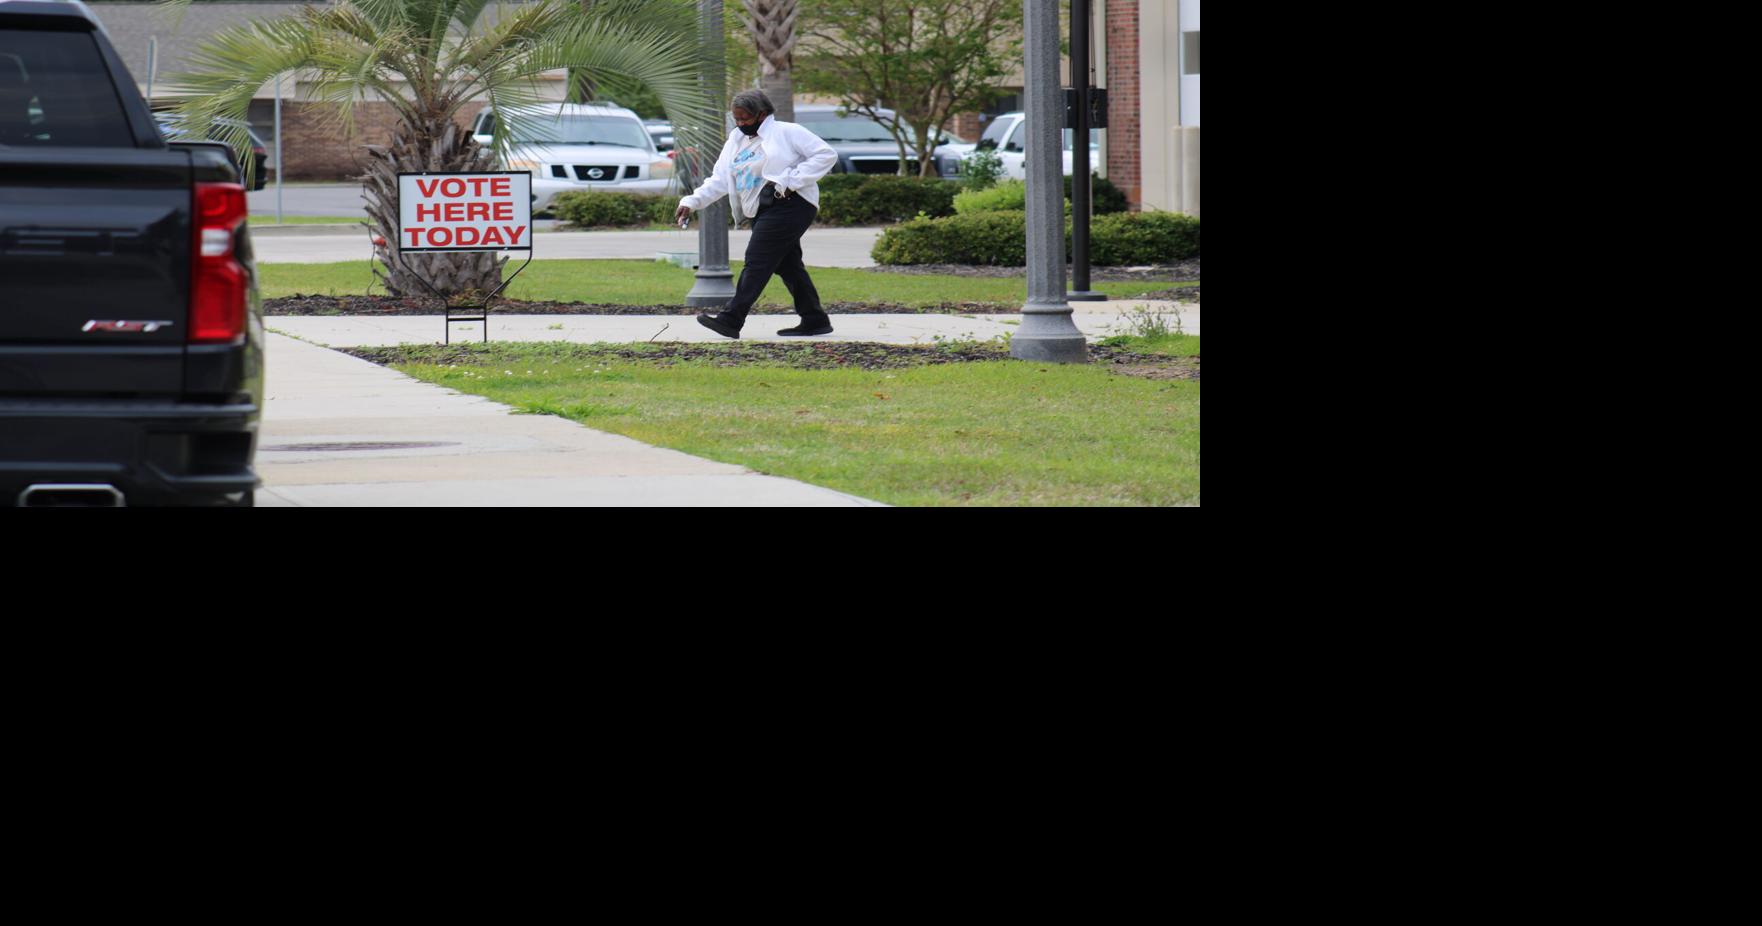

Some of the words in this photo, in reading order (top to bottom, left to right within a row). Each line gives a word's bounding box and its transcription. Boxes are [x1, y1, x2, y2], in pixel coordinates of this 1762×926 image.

[416, 177, 512, 198] VOTE
[416, 201, 513, 223] HERE
[403, 225, 526, 247] TODAY
